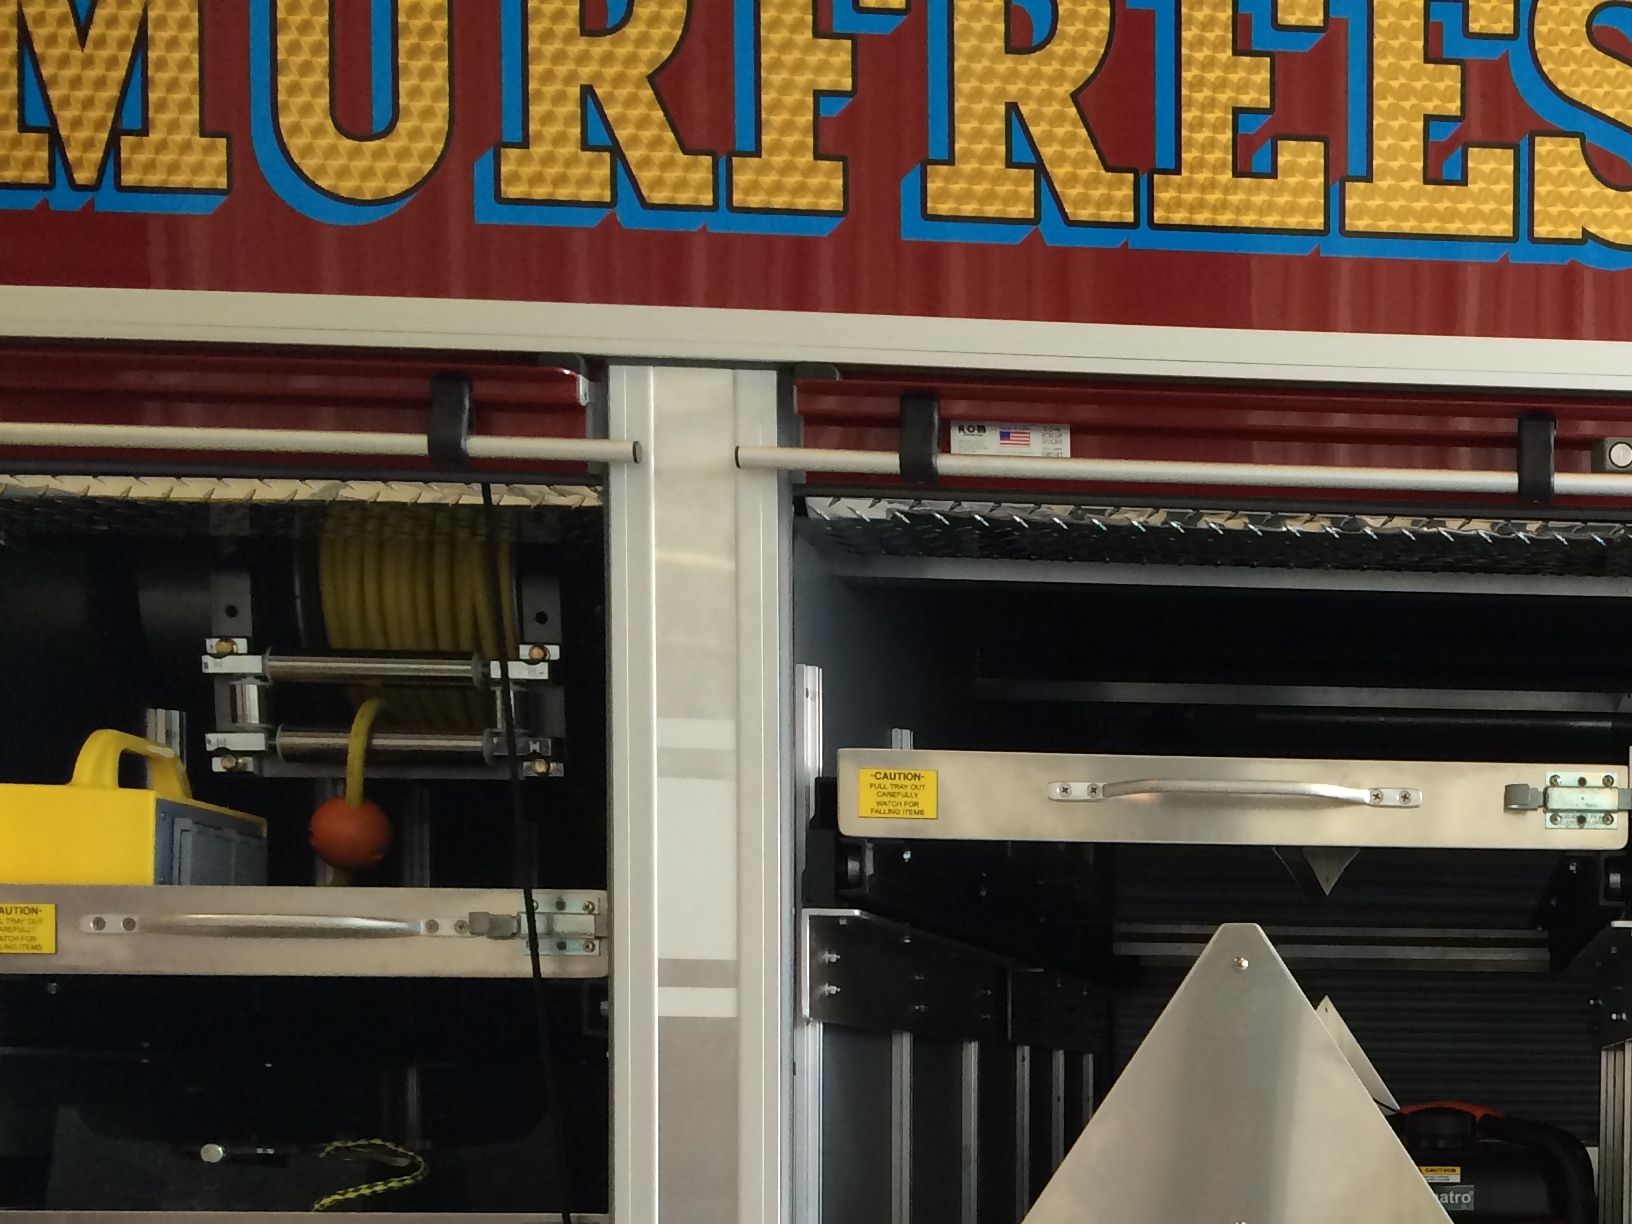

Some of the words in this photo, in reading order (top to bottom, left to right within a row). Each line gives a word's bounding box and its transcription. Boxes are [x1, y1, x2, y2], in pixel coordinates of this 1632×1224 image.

[869, 782, 888, 790] PULL
[910, 783, 925, 791] OUT
[876, 790, 918, 798] CAREFULLY
[902, 808, 925, 816] ITEMS
